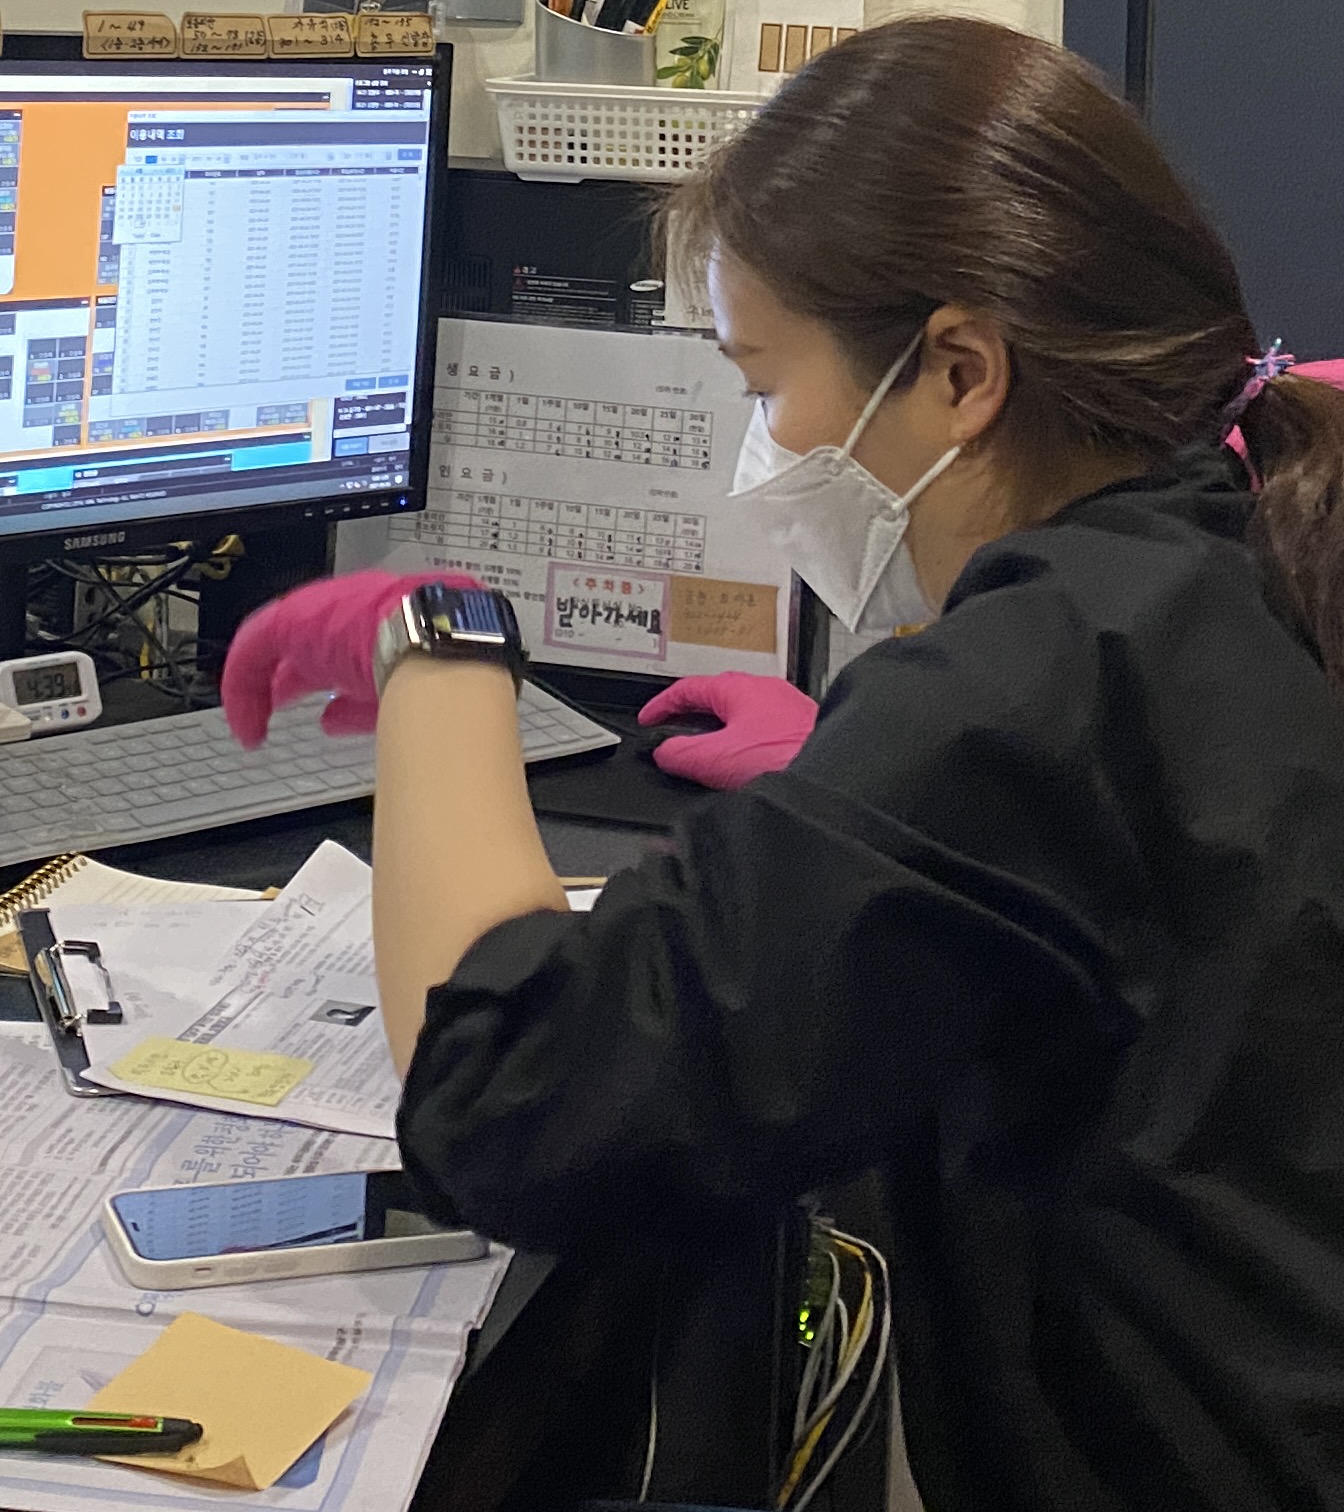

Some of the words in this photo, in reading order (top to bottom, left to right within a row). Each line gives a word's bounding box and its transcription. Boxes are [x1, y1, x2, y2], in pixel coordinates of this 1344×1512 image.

[130, 129, 165, 140] 이용내역
[166, 129, 184, 140] 조회
[64, 531, 126, 550] SAMSUNG
